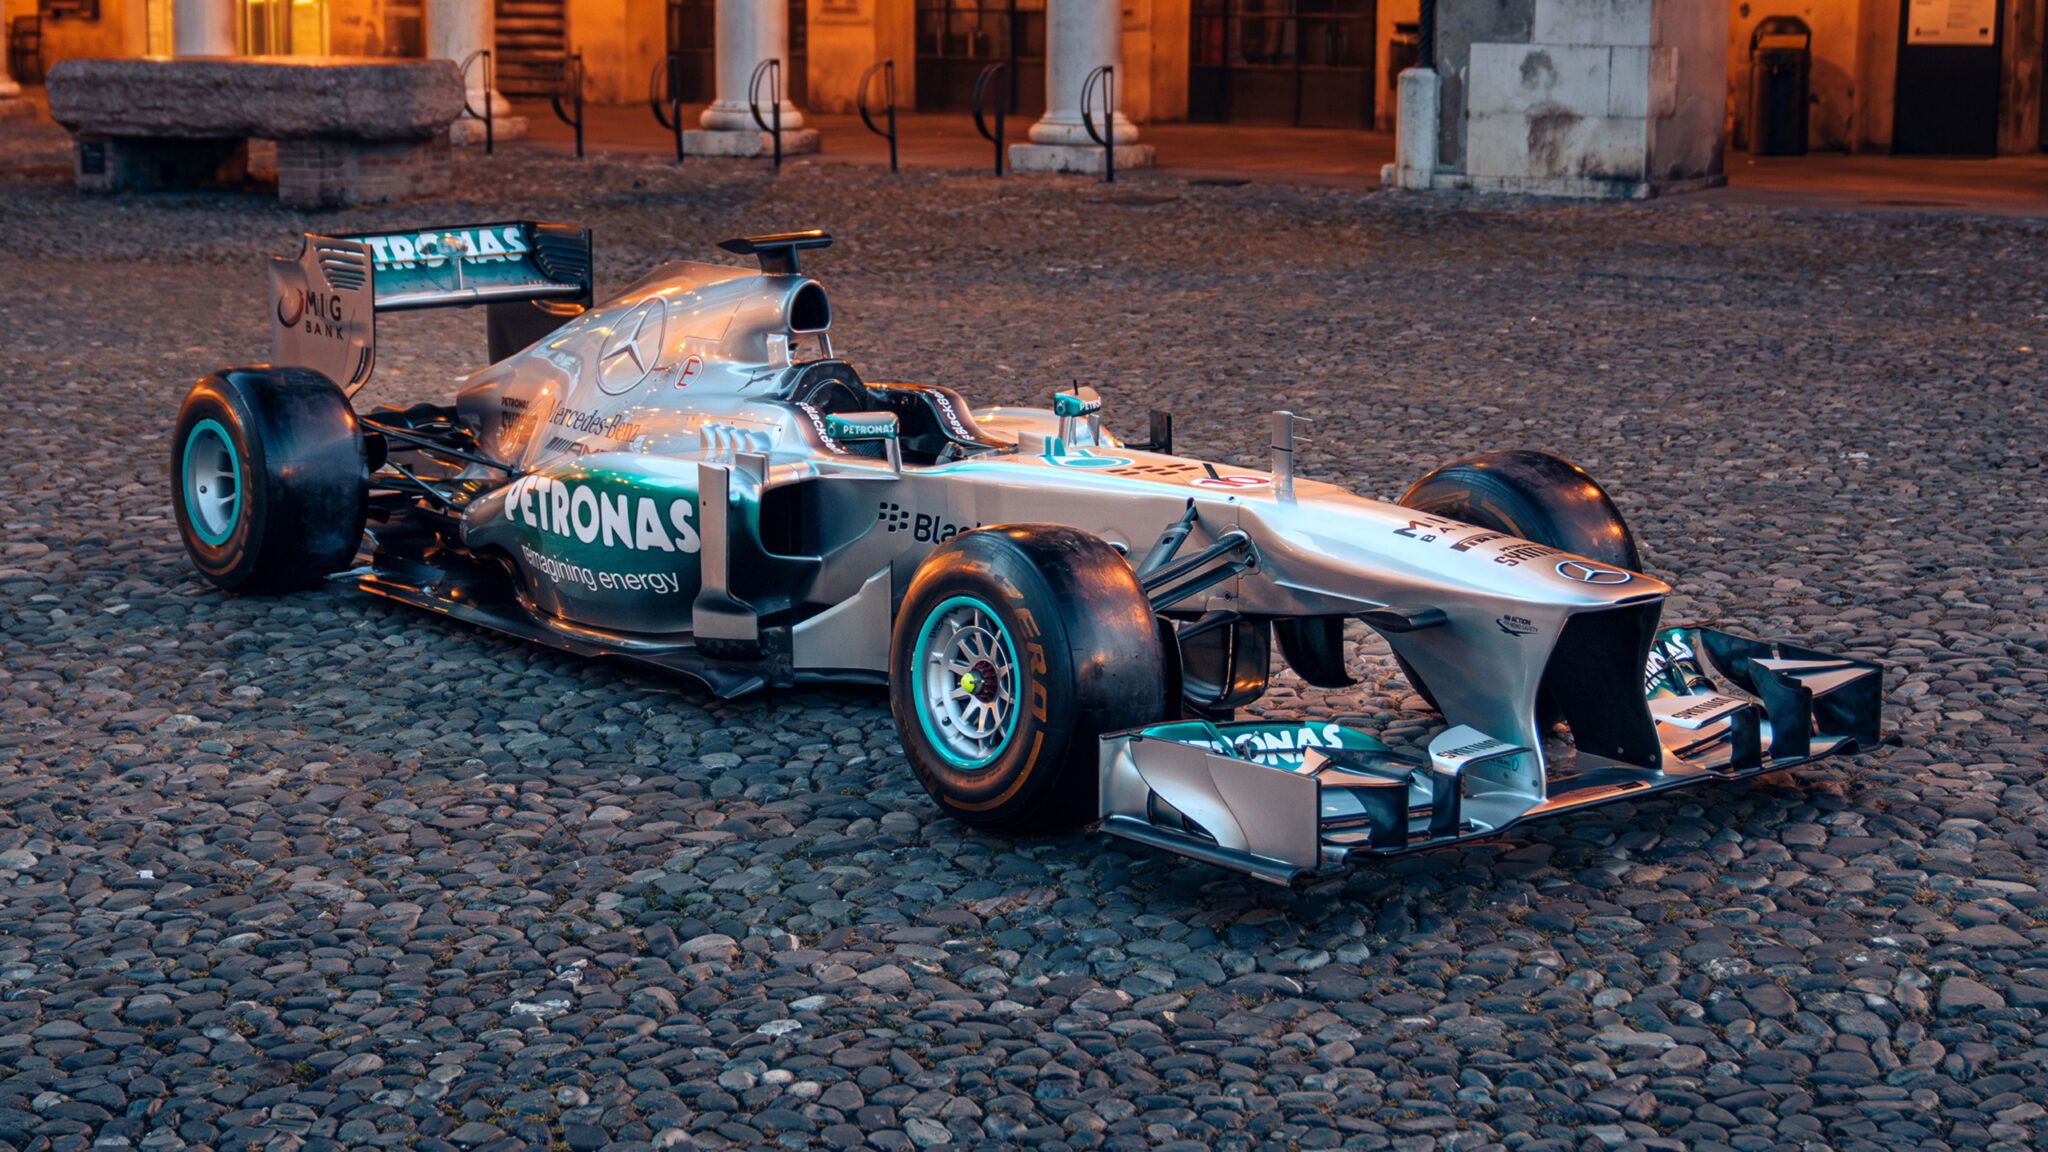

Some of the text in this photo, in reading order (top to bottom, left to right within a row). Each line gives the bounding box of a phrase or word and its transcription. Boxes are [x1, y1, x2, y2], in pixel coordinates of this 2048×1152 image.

[305, 290, 342, 321] MIG
[306, 321, 344, 340] BANK
[676, 359, 700, 387] E
[546, 399, 641, 443] Mercedes-Benz
[842, 424, 894, 434] PETRONAS
[505, 474, 701, 554] PETRONAS
[521, 543, 598, 592] reimagining
[599, 571, 680, 595] energy
